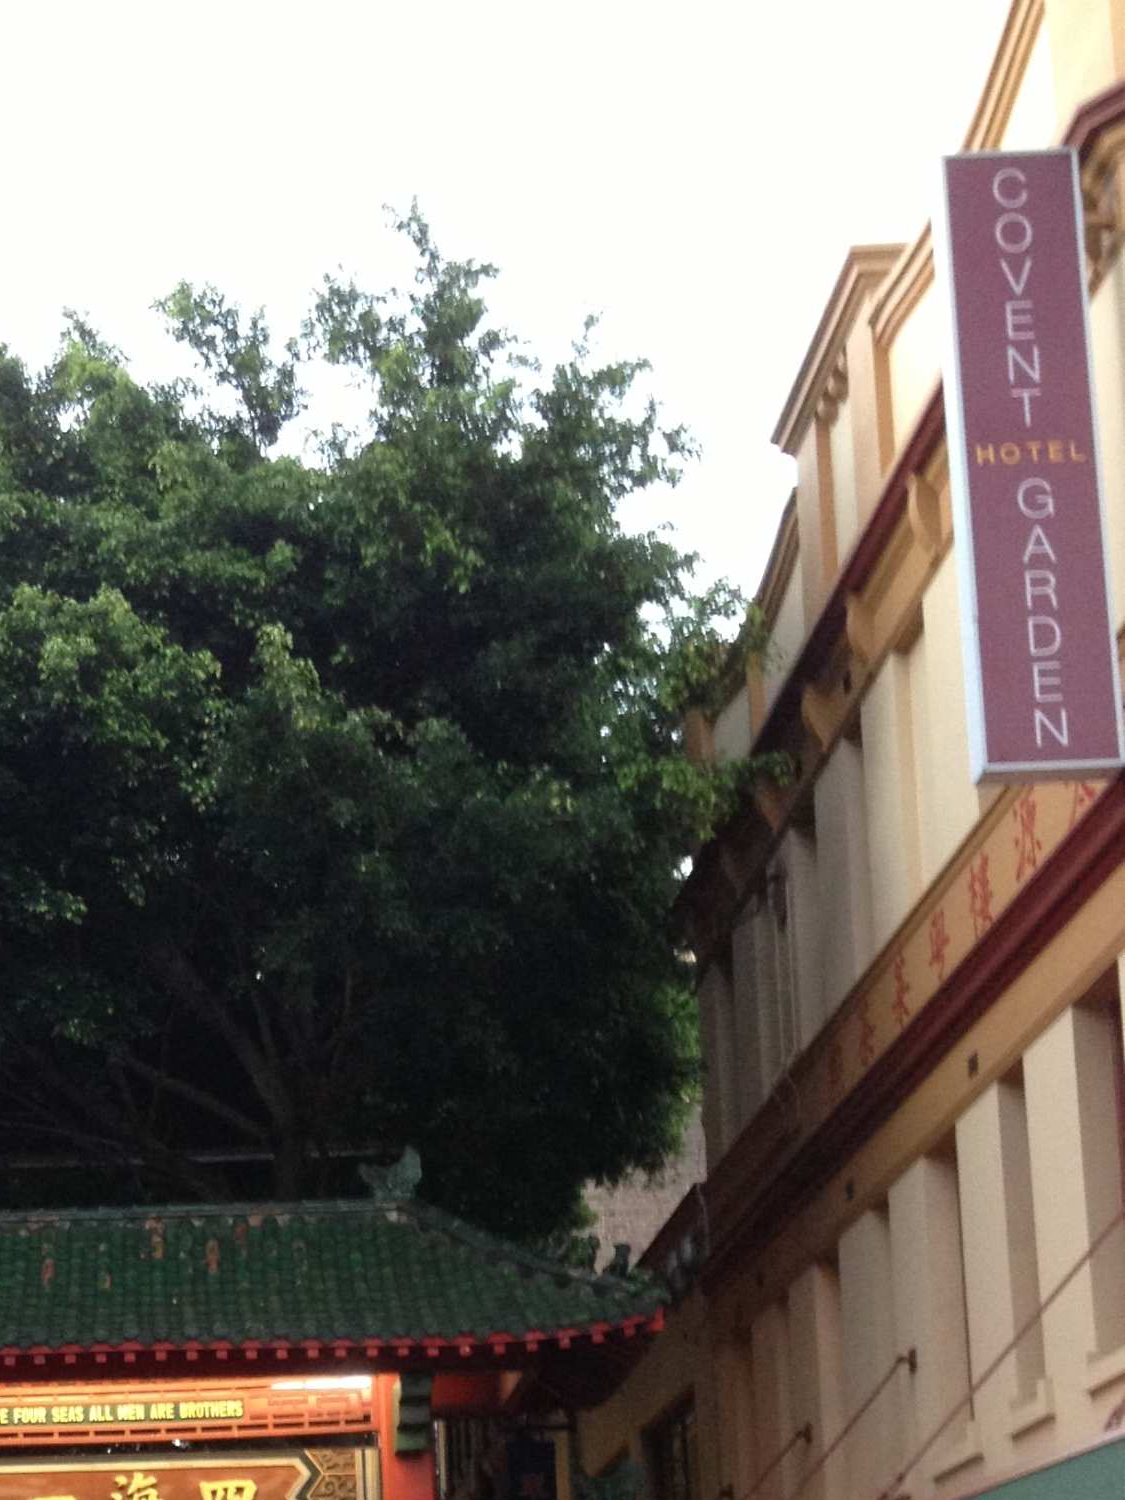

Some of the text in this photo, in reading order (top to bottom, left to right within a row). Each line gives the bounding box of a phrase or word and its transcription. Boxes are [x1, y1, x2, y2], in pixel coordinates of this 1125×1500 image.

[992, 167, 1042, 428] COVENT
[975, 440, 1088, 467] HOTEL
[1017, 477, 1070, 748] GARDEN
[13, 1406, 47, 1424] FOUR
[52, 1405, 84, 1423] SEAS
[89, 1404, 114, 1422] ALL
[118, 1403, 145, 1421] MEN
[150, 1402, 175, 1420] ARE
[179, 1400, 244, 1419] BROTHERS
